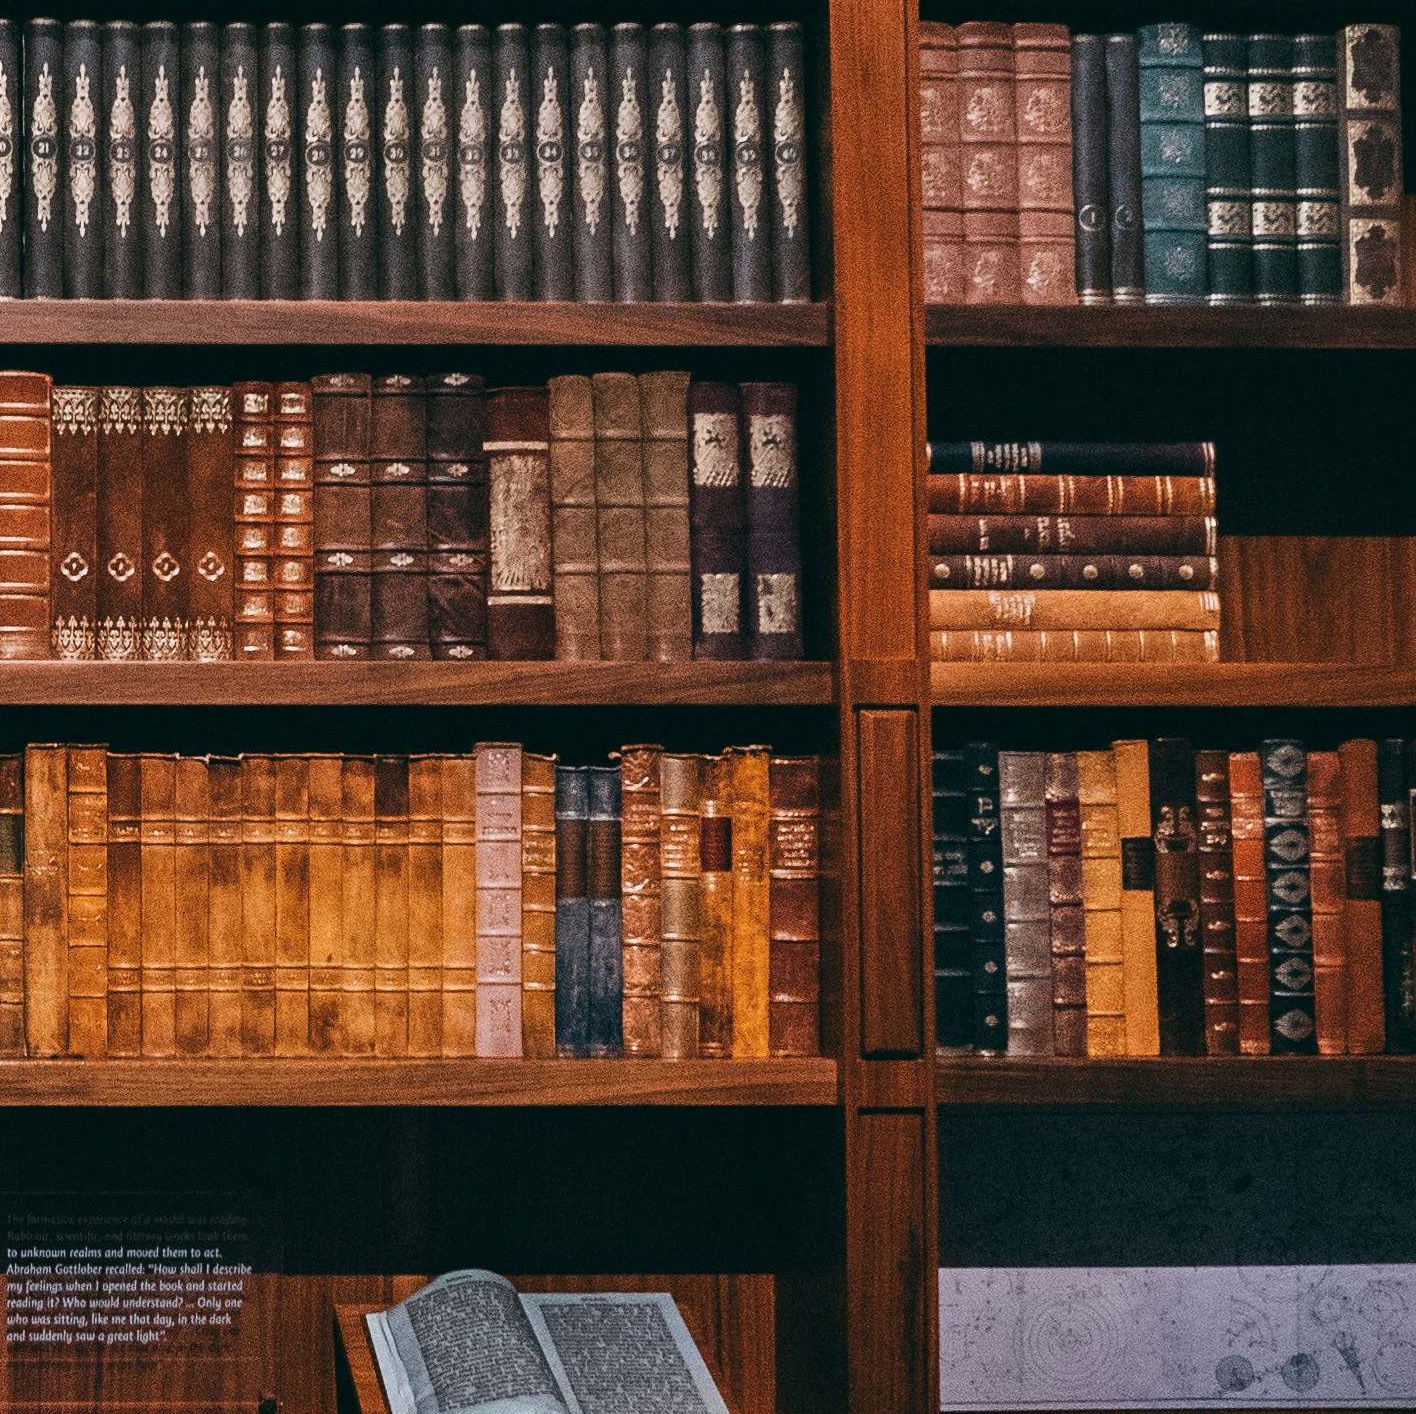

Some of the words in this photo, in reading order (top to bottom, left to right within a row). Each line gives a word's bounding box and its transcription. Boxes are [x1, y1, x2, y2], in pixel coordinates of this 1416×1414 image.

[6, 1247, 18, 1259] to
[20, 1246, 67, 1259] unknown
[69, 1246, 102, 1258] realms
[103, 1246, 124, 1259] and
[126, 1246, 160, 1259] moved
[161, 1246, 188, 1258] them
[190, 1247, 202, 1259] to
[203, 1247, 223, 1259] act.
[5, 1263, 52, 1276] Abraham
[54, 1263, 103, 1276] Gottlober
[104, 1263, 145, 1276] recalled:
[179, 1262, 203, 1275] shall
[212, 1262, 253, 1276] describe
[6, 1282, 23, 1295] my
[25, 1280, 64, 1294] feelings
[65, 1280, 93, 1292] when
[102, 1279, 138, 1294] opened
[139, 1279, 157, 1292] the
[158, 1279, 184, 1292] book
[185, 1279, 206, 1292] and
[207, 1279, 244, 1292] started
[6, 1297, 44, 1311] reading
[46, 1297, 60, 1309] it?
[62, 1296, 87, 1309] Who
[89, 1296, 120, 1309] would
[122, 1296, 184, 1309] understand?
[196, 1296, 222, 1311] Only
[224, 1298, 243, 1309] one
